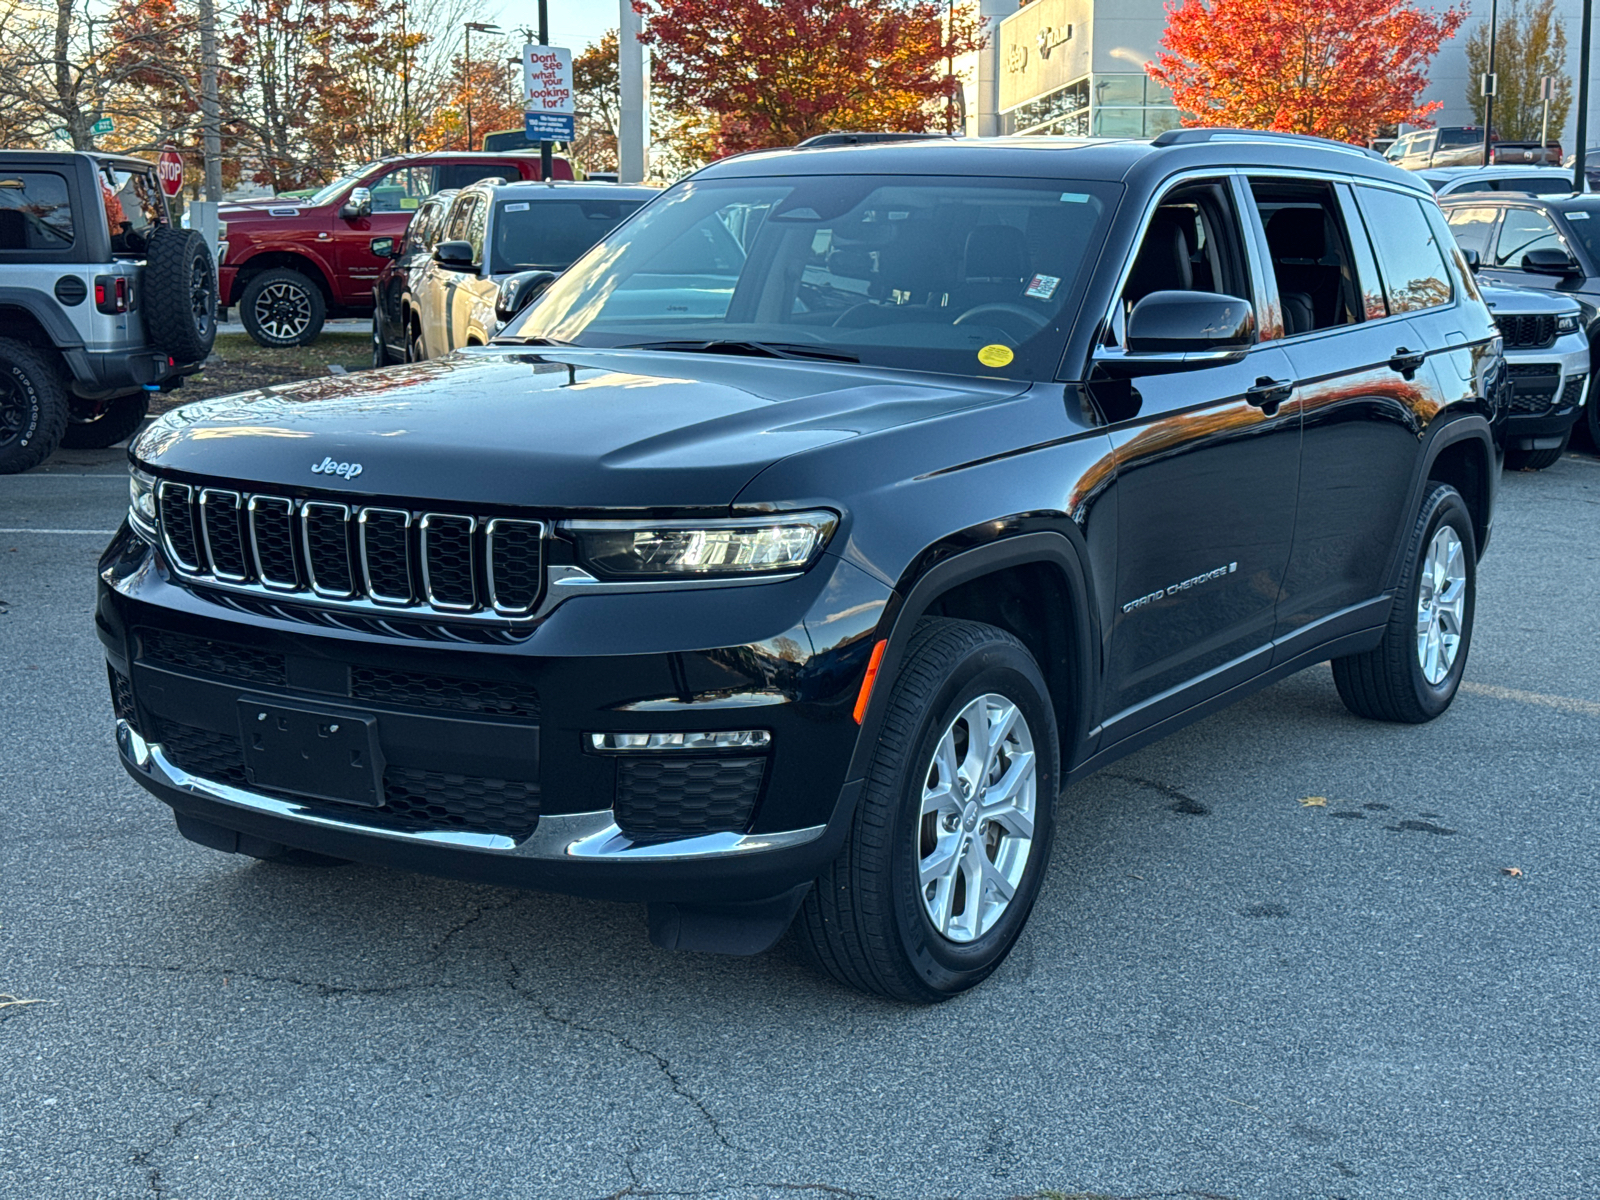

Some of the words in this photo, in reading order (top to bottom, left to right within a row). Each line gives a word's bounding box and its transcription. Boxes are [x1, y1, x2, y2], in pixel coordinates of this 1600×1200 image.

[530, 52, 557, 63] Dont
[543, 62, 563, 71] see
[531, 70, 556, 80] what
[542, 78, 563, 88] your
[530, 87, 570, 99] looking
[542, 97, 564, 108] for?
[160, 162, 181, 182] STOP
[311, 456, 363, 481] Jeep
[1122, 588, 1164, 614] GRAND
[1166, 565, 1228, 596] CHEROKEE
